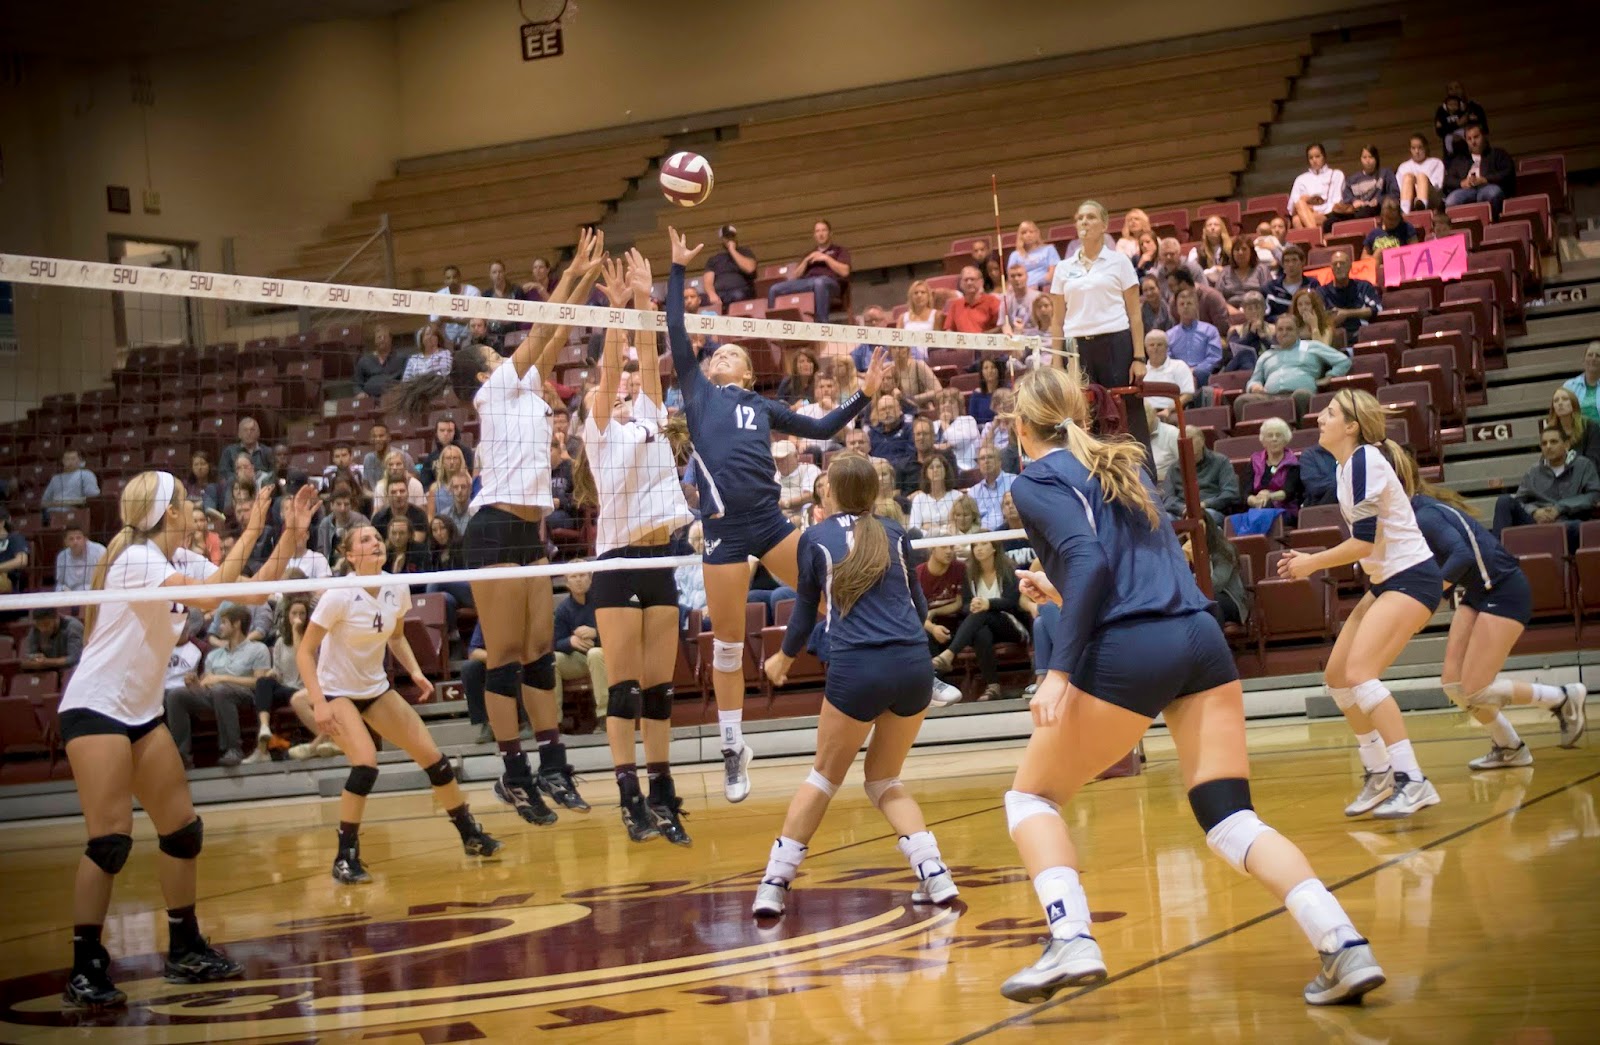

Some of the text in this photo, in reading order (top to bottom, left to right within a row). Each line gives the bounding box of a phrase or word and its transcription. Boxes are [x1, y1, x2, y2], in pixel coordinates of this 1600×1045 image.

[526, 32, 559, 58] EE
[1391, 244, 1459, 280] TAY
[29, 260, 58, 278] SPU
[112, 268, 139, 285] SPU
[189, 274, 214, 291] SPU
[261, 281, 284, 298] SPU
[328, 287, 351, 303] SPU
[392, 293, 412, 308] SPU
[451, 298, 470, 312] SPU
[506, 302, 524, 317] SPU
[559, 307, 576, 320] SPU
[609, 310, 625, 324] SPU
[656, 314, 667, 327] SP
[700, 316, 715, 330] SPU
[742, 320, 757, 333] SPU
[782, 323, 796, 335] SPU
[820, 325, 834, 337] SPU
[735, 403, 758, 430] 12
[1494, 424, 1509, 441] G
[373, 611, 384, 633] 4
